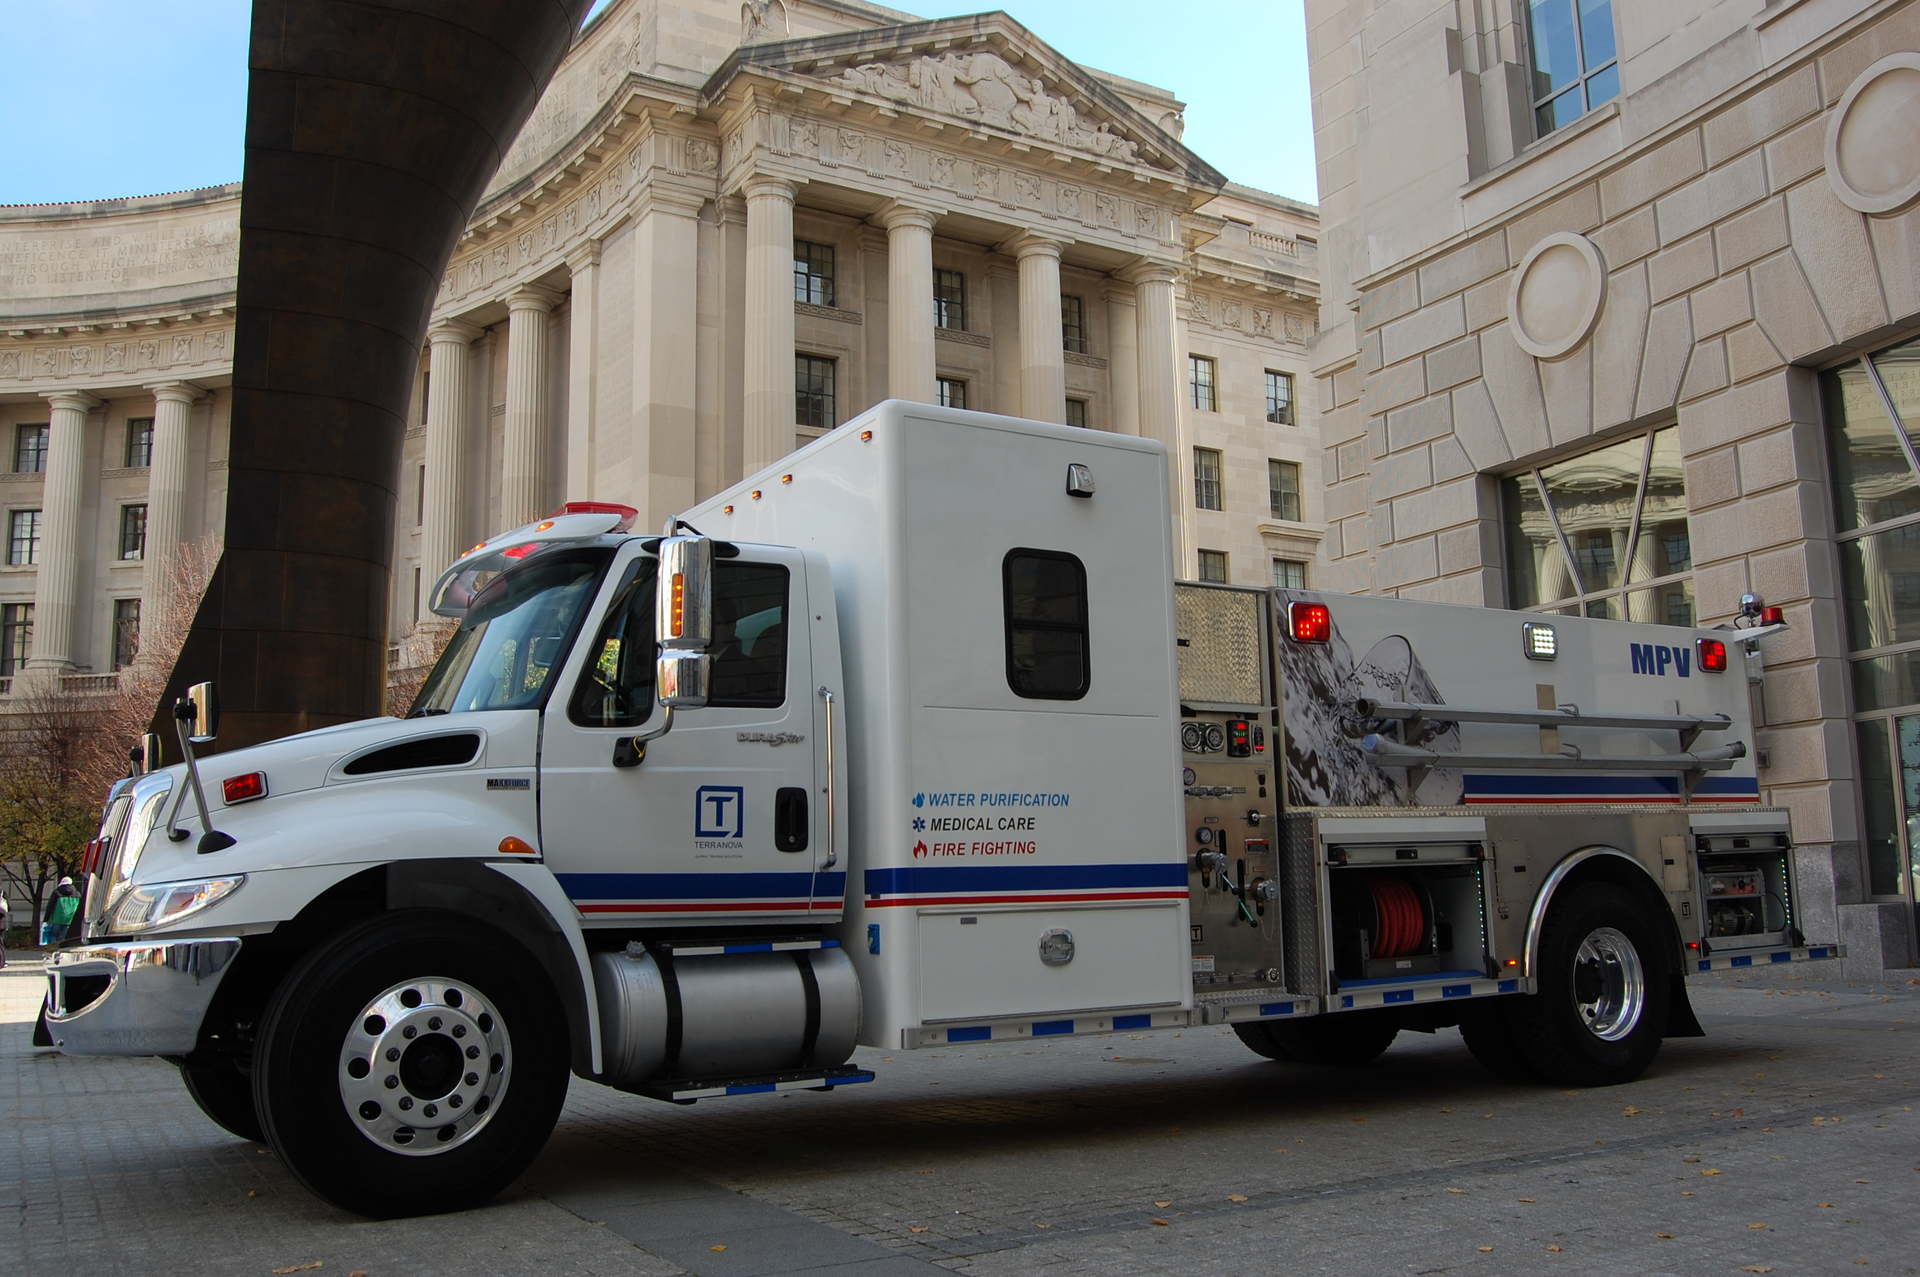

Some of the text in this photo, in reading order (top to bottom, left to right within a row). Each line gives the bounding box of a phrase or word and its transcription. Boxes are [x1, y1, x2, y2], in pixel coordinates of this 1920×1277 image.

[132, 229, 176, 243] WHILE
[117, 238, 190, 257] MINISTERS
[4, 261, 80, 275] THROUGH
[88, 256, 135, 271] WHICH
[143, 250, 178, 264] ALIKE
[2, 273, 37, 286] WHO
[47, 271, 94, 284] LISTEN
[104, 267, 129, 280] FOR
[139, 260, 178, 276] THEIR
[1630, 642, 1691, 678] MPV
[928, 793, 1070, 807] WATER PURIFICATION
[930, 817, 1036, 831] MEDICAL CARE
[694, 841, 744, 850] TERRANOVA
[932, 841, 1037, 857] FIRE FIGHTING
